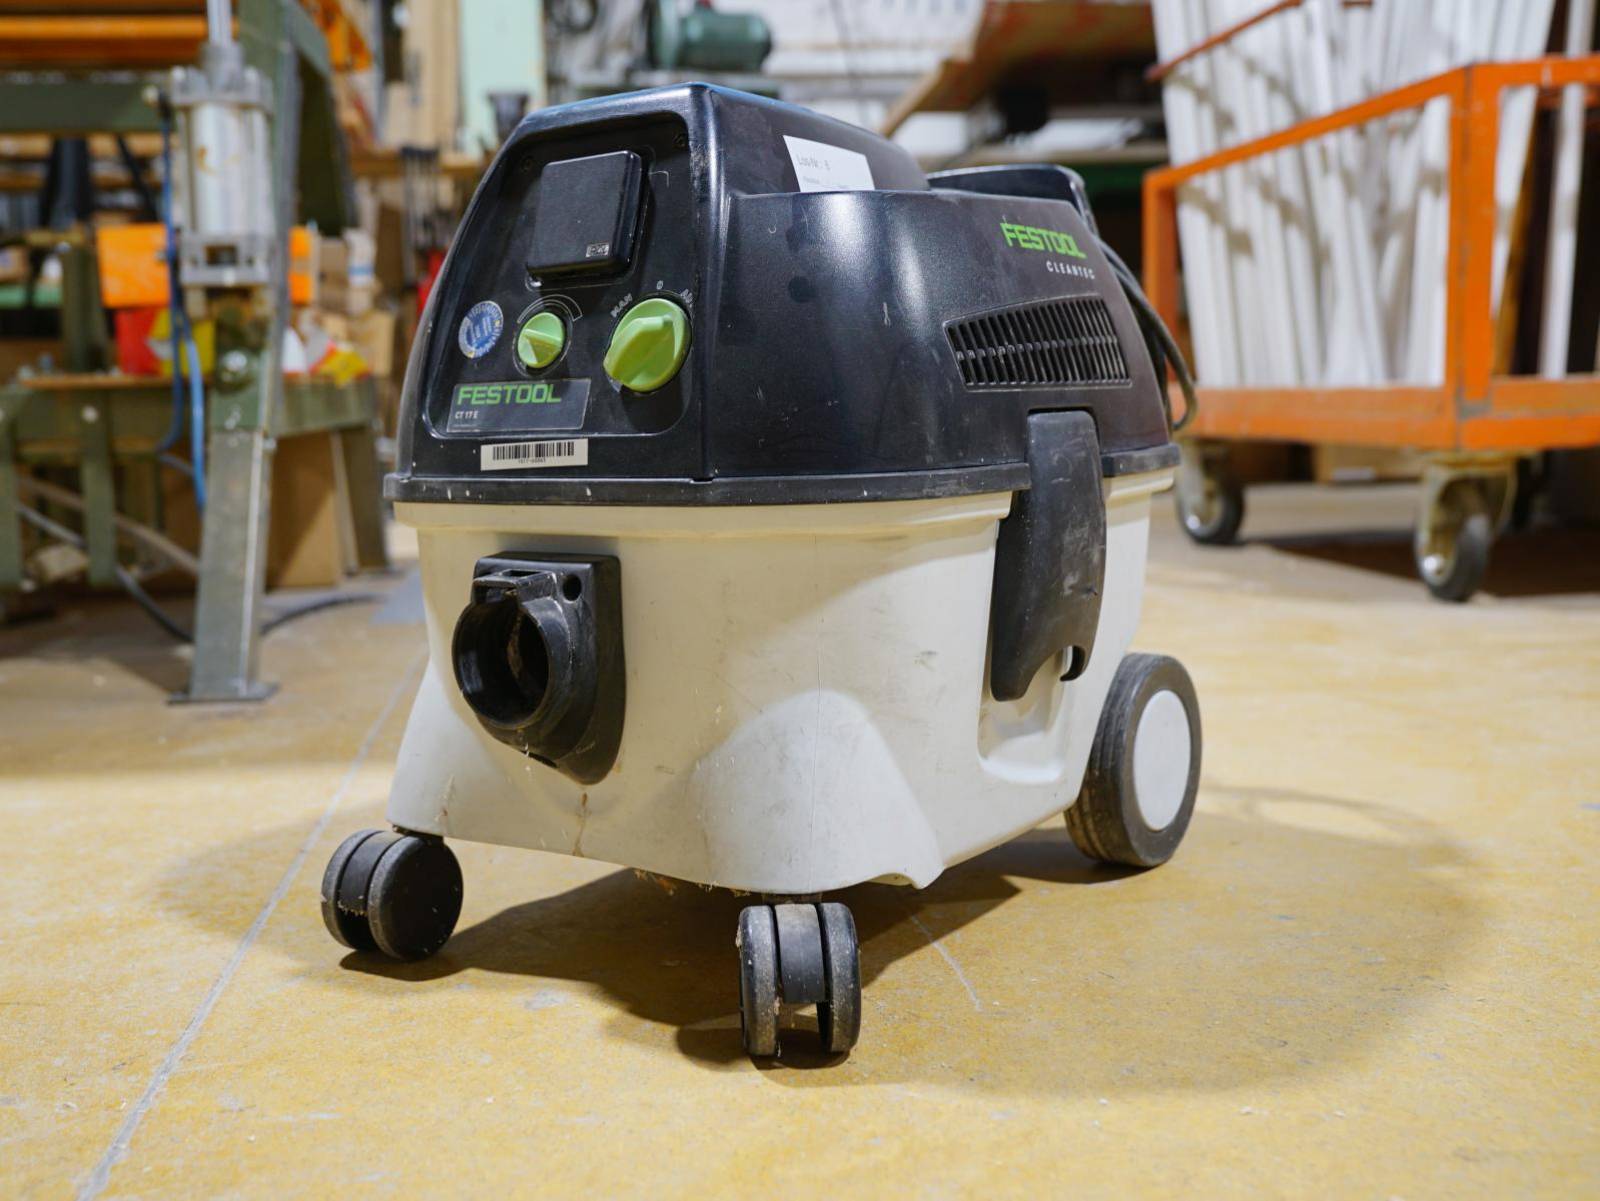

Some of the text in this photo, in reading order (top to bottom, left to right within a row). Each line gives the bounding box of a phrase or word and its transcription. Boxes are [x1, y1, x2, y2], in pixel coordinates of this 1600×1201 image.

[1000, 222, 1086, 259] FESTOOL
[1046, 260, 1095, 279] CLEANTEC
[457, 383, 562, 406] FESTOOL
[454, 411, 465, 419] CT
